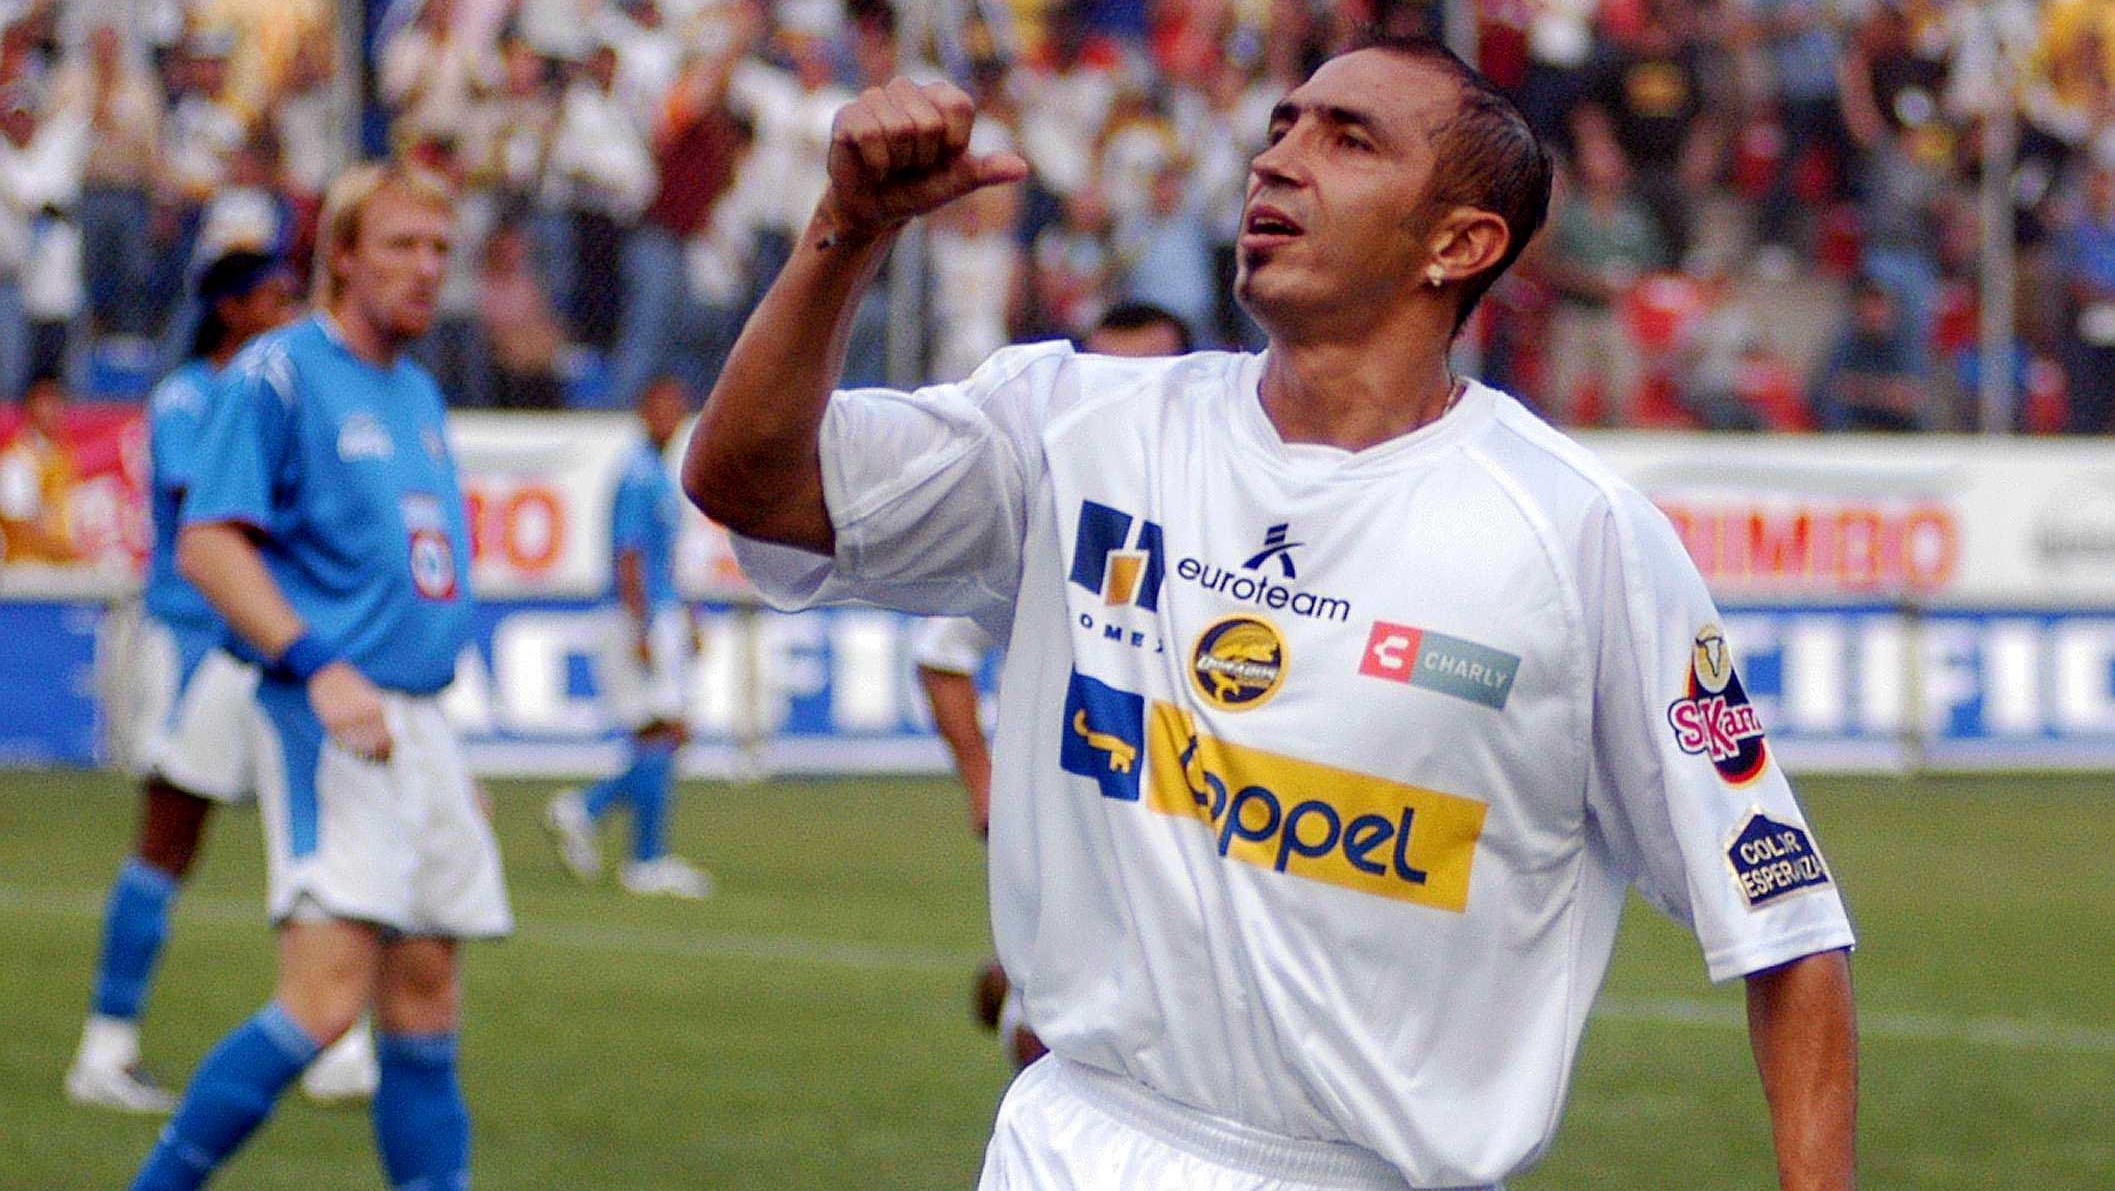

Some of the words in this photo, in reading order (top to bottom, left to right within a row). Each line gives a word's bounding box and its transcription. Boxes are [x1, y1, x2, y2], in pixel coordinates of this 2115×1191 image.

[1656, 500, 1963, 590] IMBO
[1177, 557, 1351, 622] euroteam
[1423, 651, 1509, 689] CHARLY
